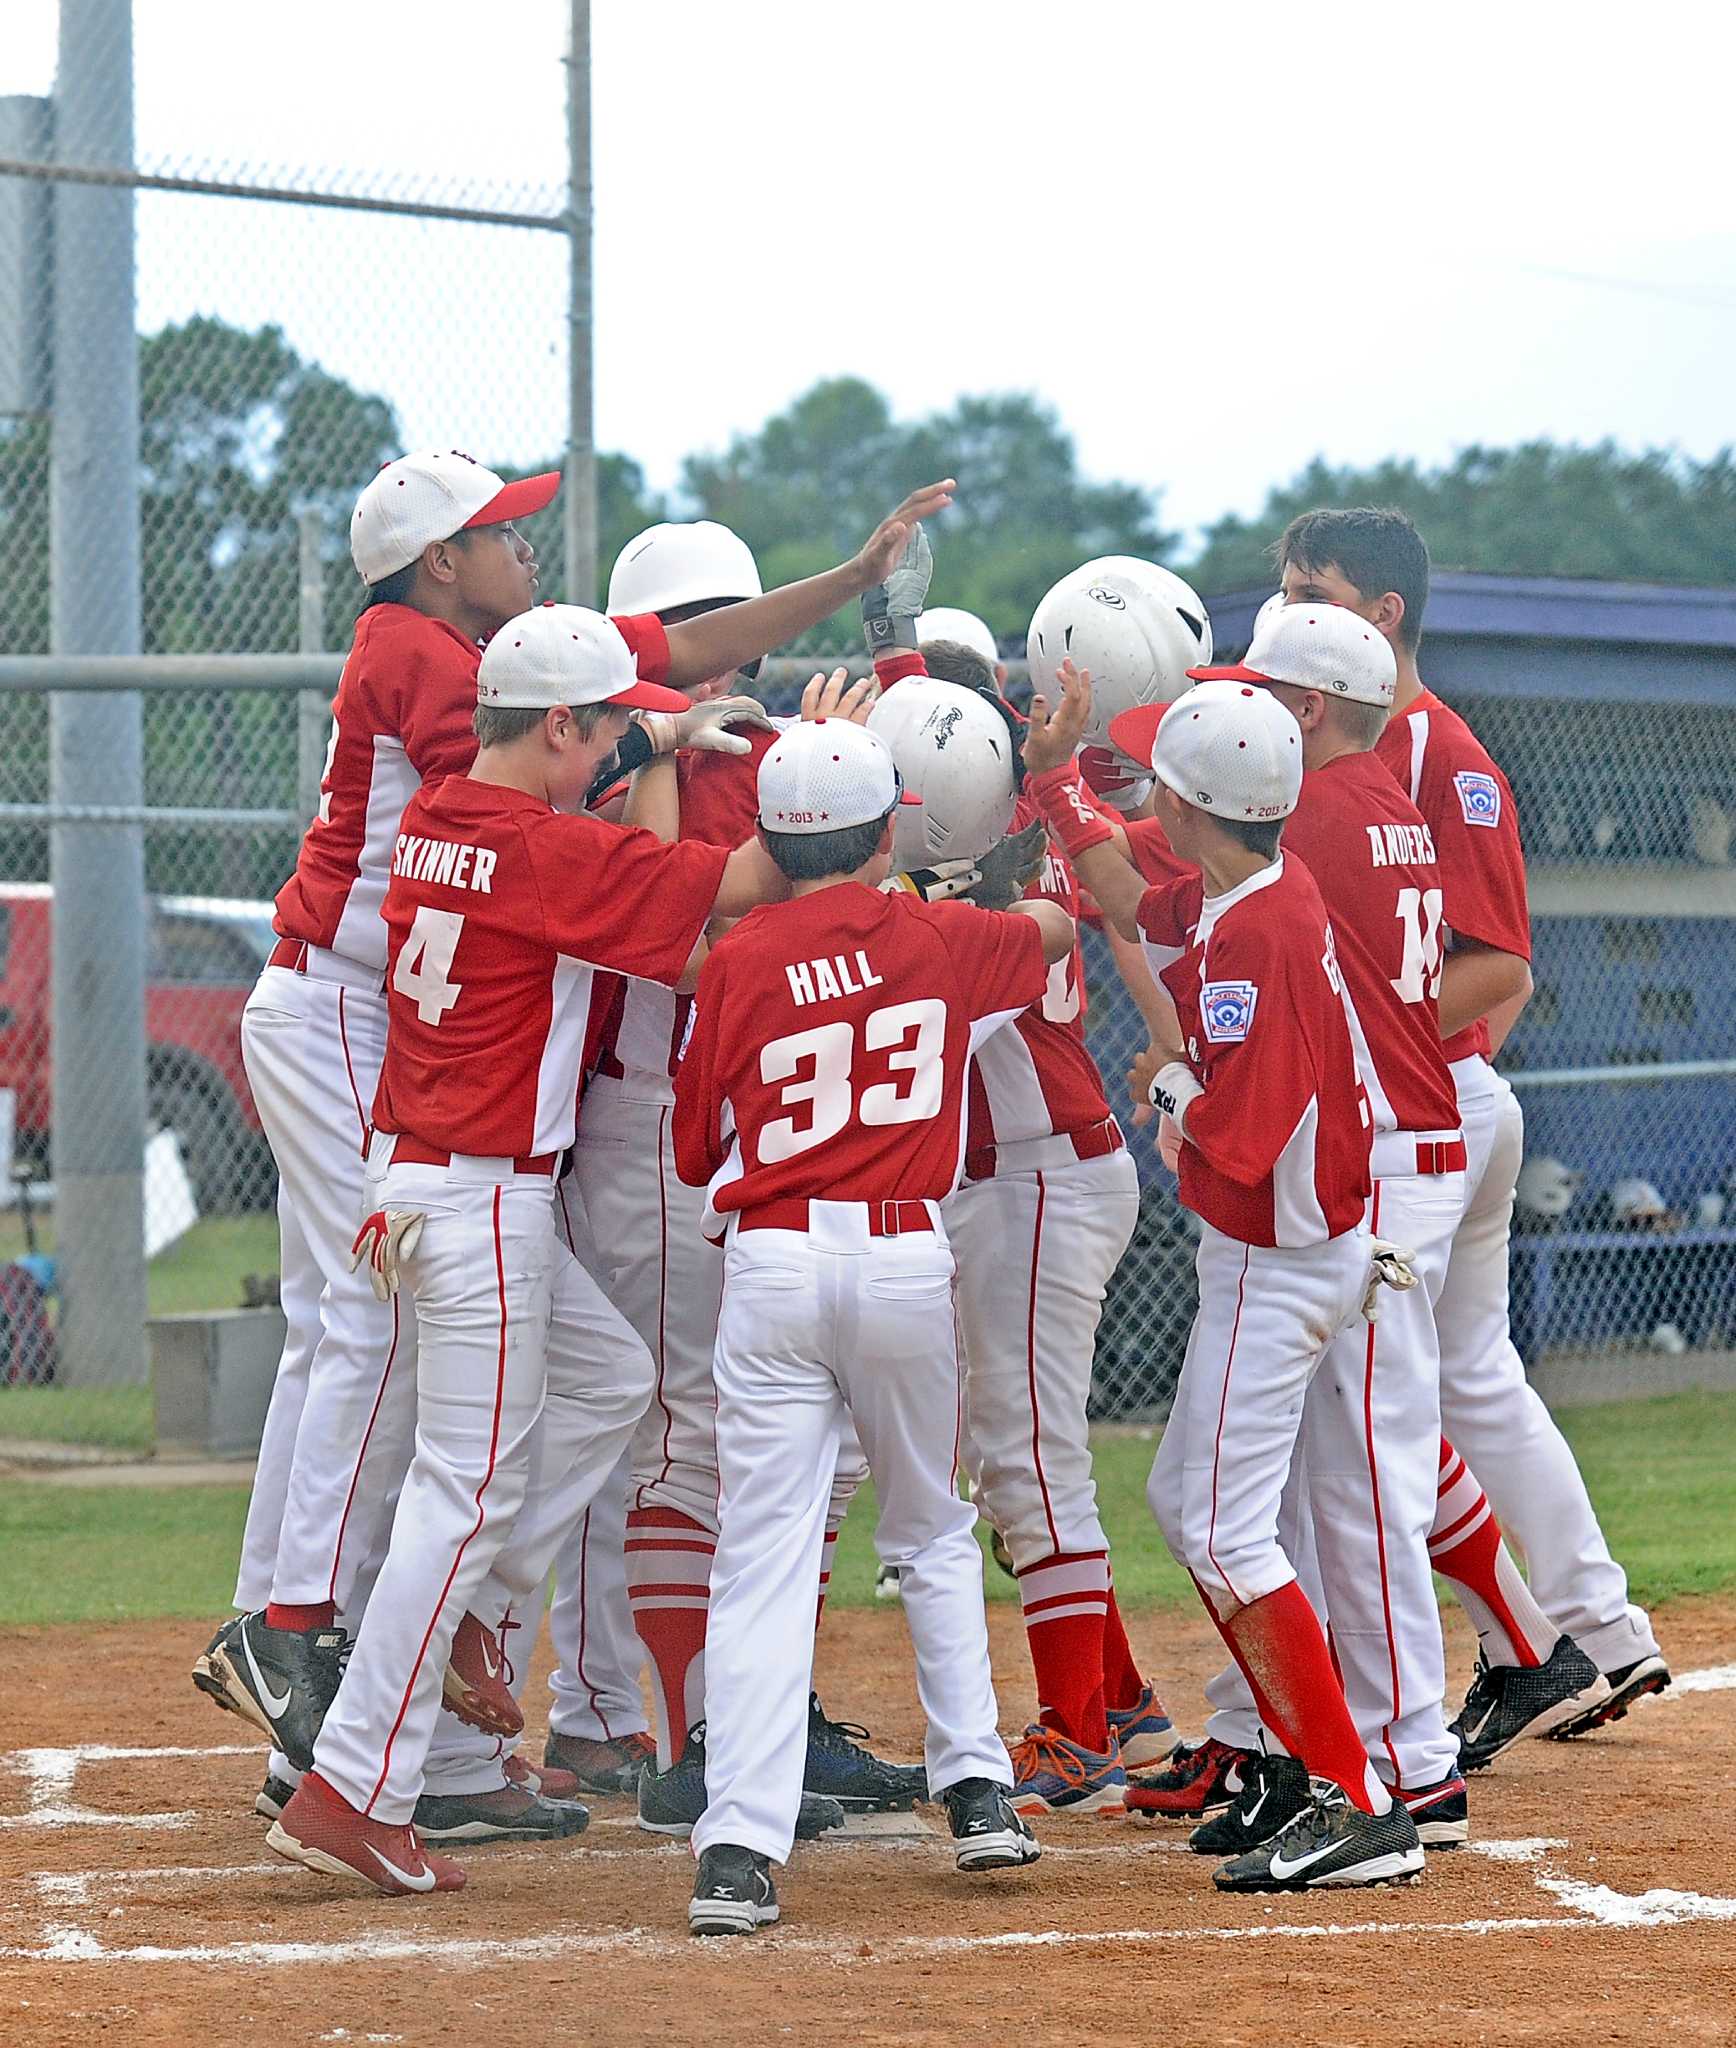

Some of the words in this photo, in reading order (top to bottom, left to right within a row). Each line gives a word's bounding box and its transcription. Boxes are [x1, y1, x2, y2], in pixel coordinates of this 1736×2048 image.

[788, 811, 815, 824] 2013
[1365, 823, 1437, 868] ANDERS
[393, 833, 498, 894] SKINNER
[392, 904, 466, 1027] 4
[784, 949, 884, 1007] HALL
[757, 998, 948, 1165] 33
